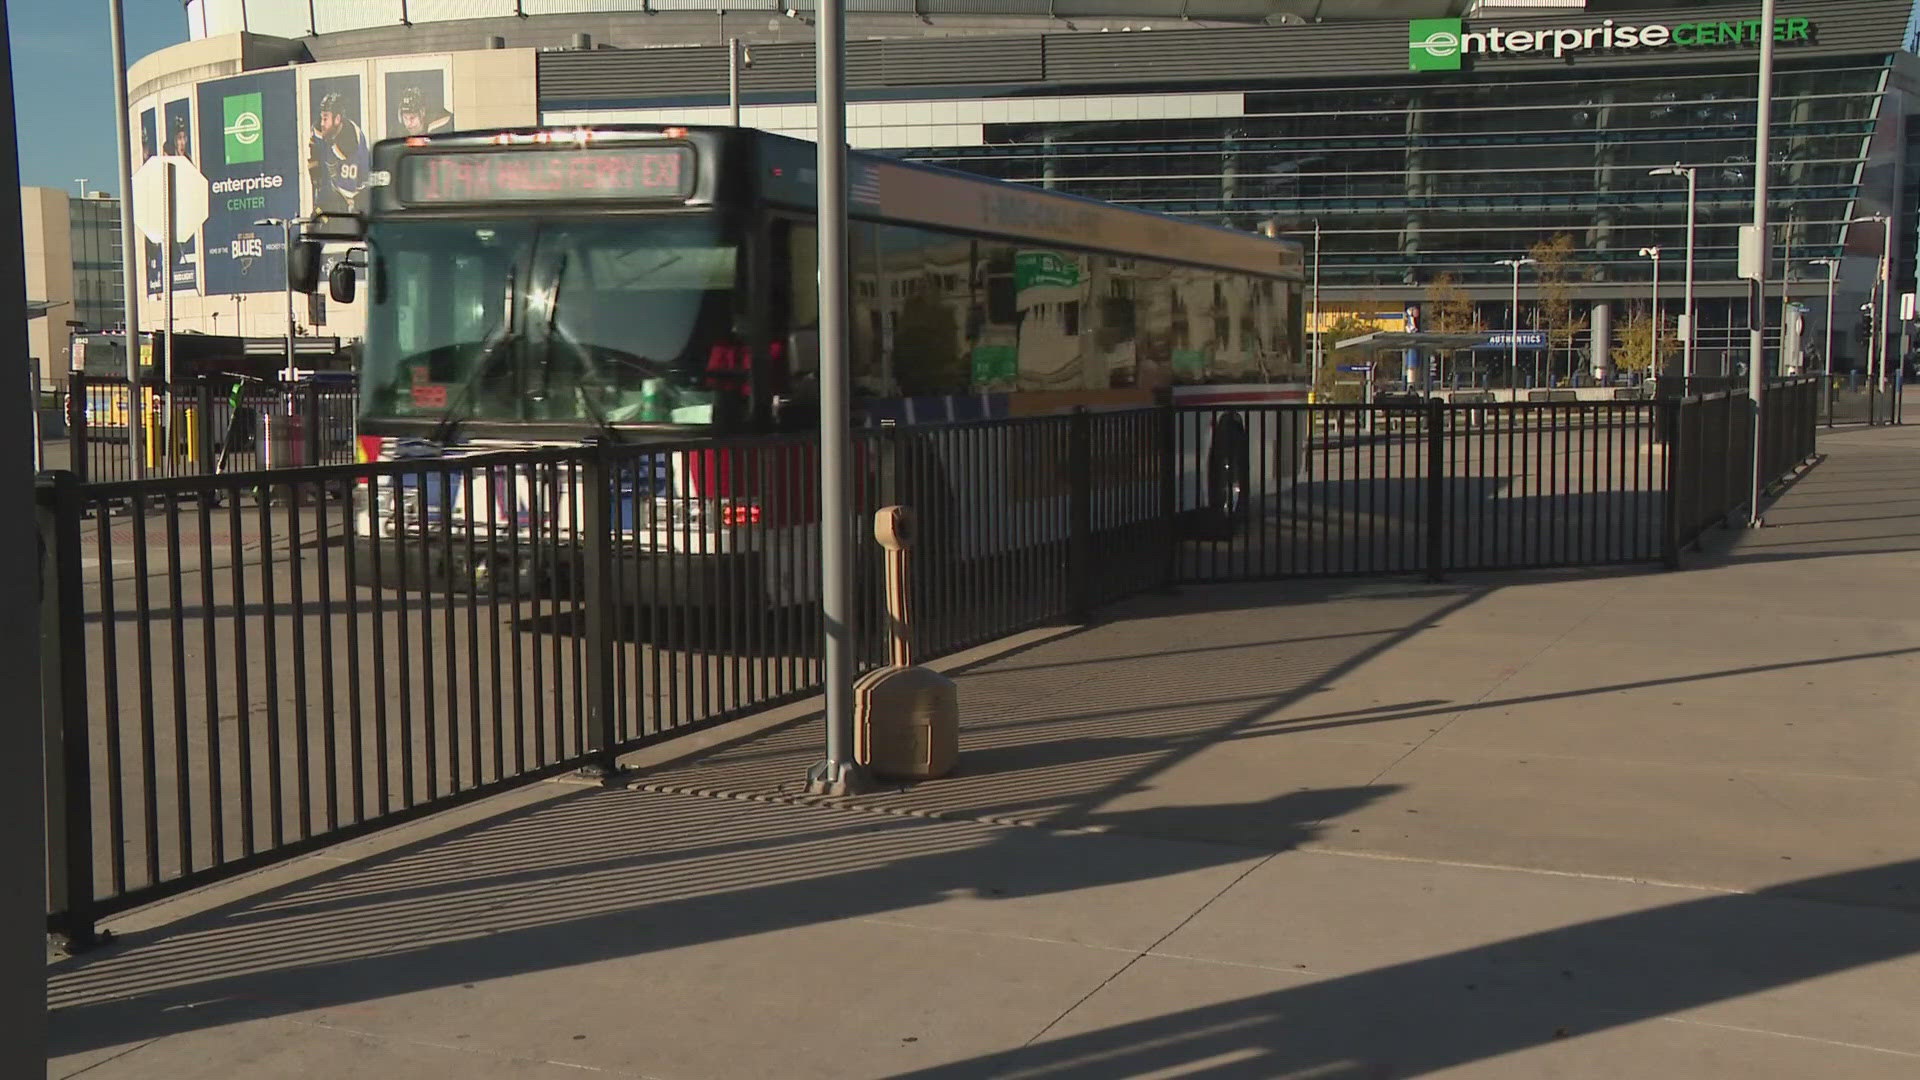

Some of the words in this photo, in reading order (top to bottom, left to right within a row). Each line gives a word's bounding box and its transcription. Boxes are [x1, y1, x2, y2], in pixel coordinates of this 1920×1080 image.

[1420, 19, 1670, 58] enterprise
[1672, 17, 1809, 45] CENTER
[340, 164, 357, 179] 90
[212, 173, 283, 194] enterprise
[227, 197, 265, 211] CENTER
[231, 239, 262, 259] BLUES
